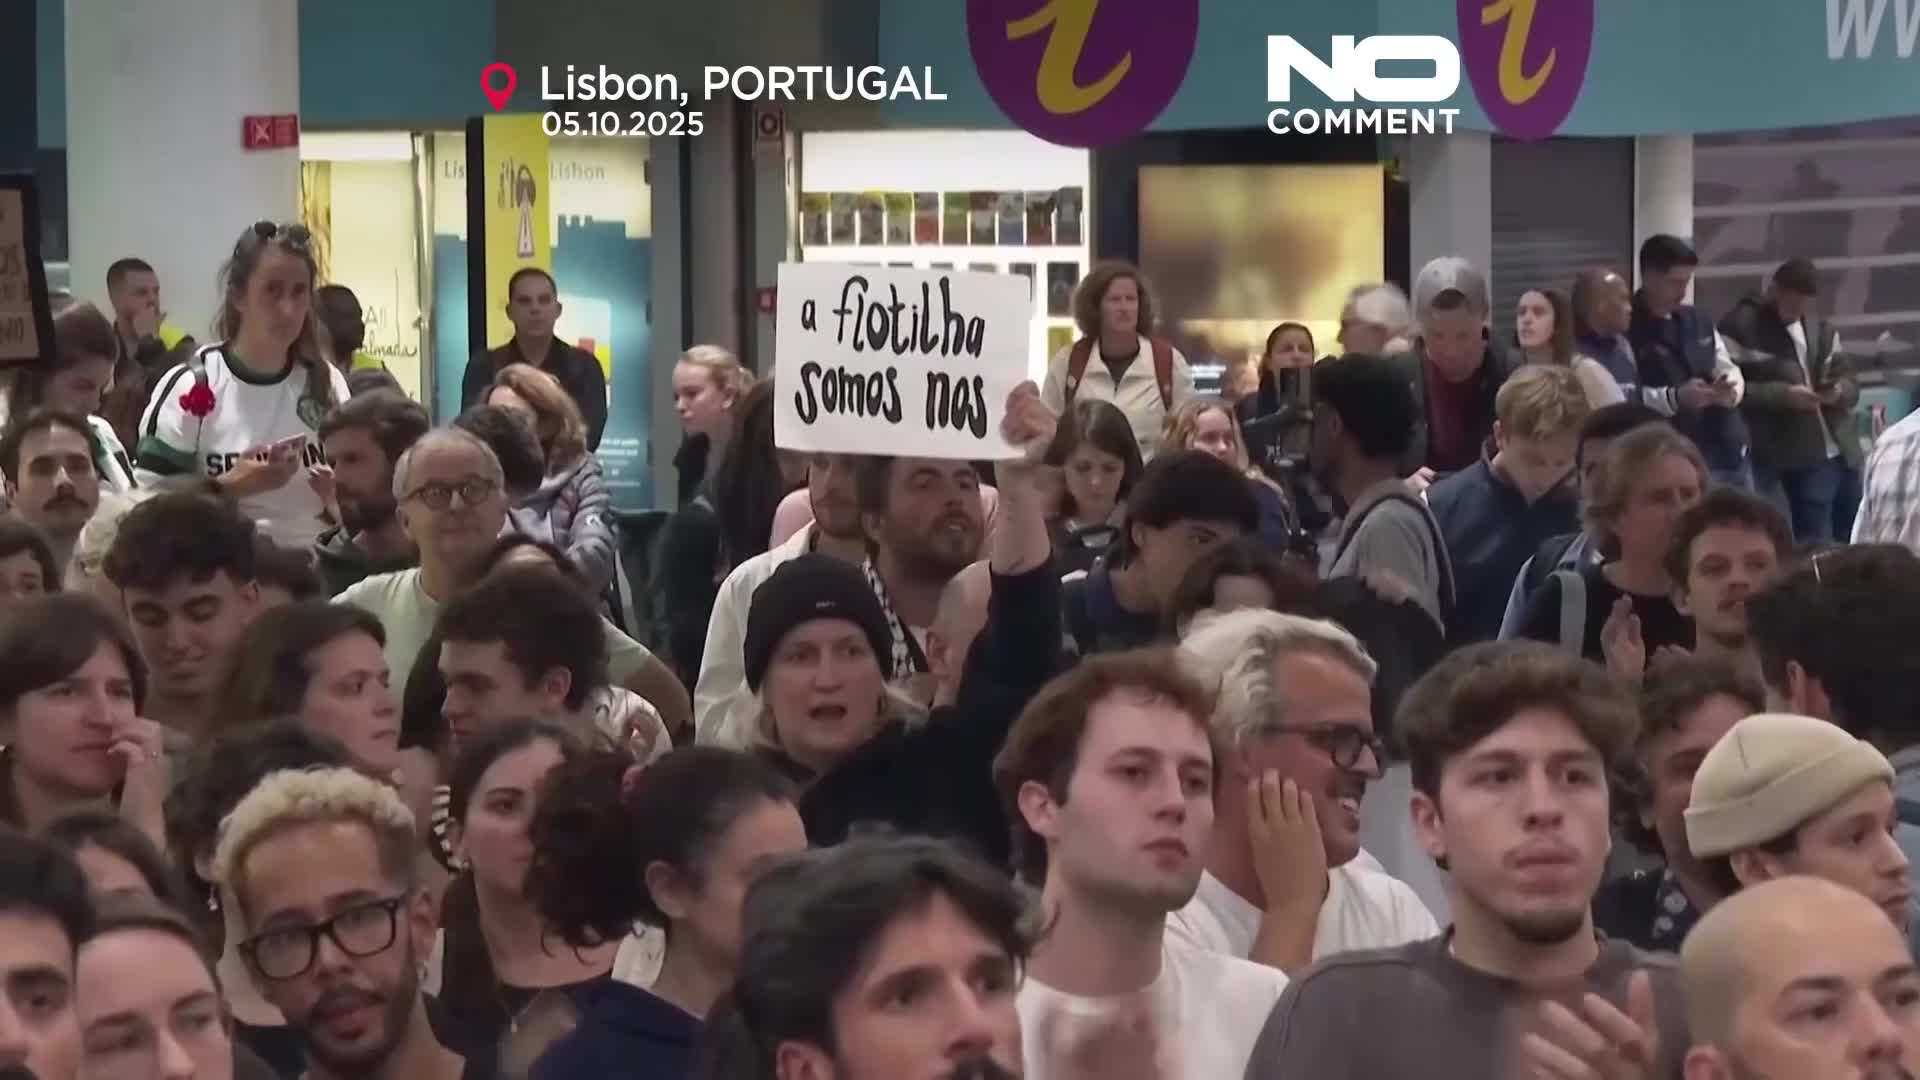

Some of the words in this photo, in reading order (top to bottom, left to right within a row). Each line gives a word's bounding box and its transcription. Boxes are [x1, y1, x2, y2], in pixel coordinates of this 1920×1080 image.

[801, 299, 817, 332] a
[832, 275, 985, 359] flotilha
[794, 361, 903, 426] somos
[925, 371, 988, 440] nos
